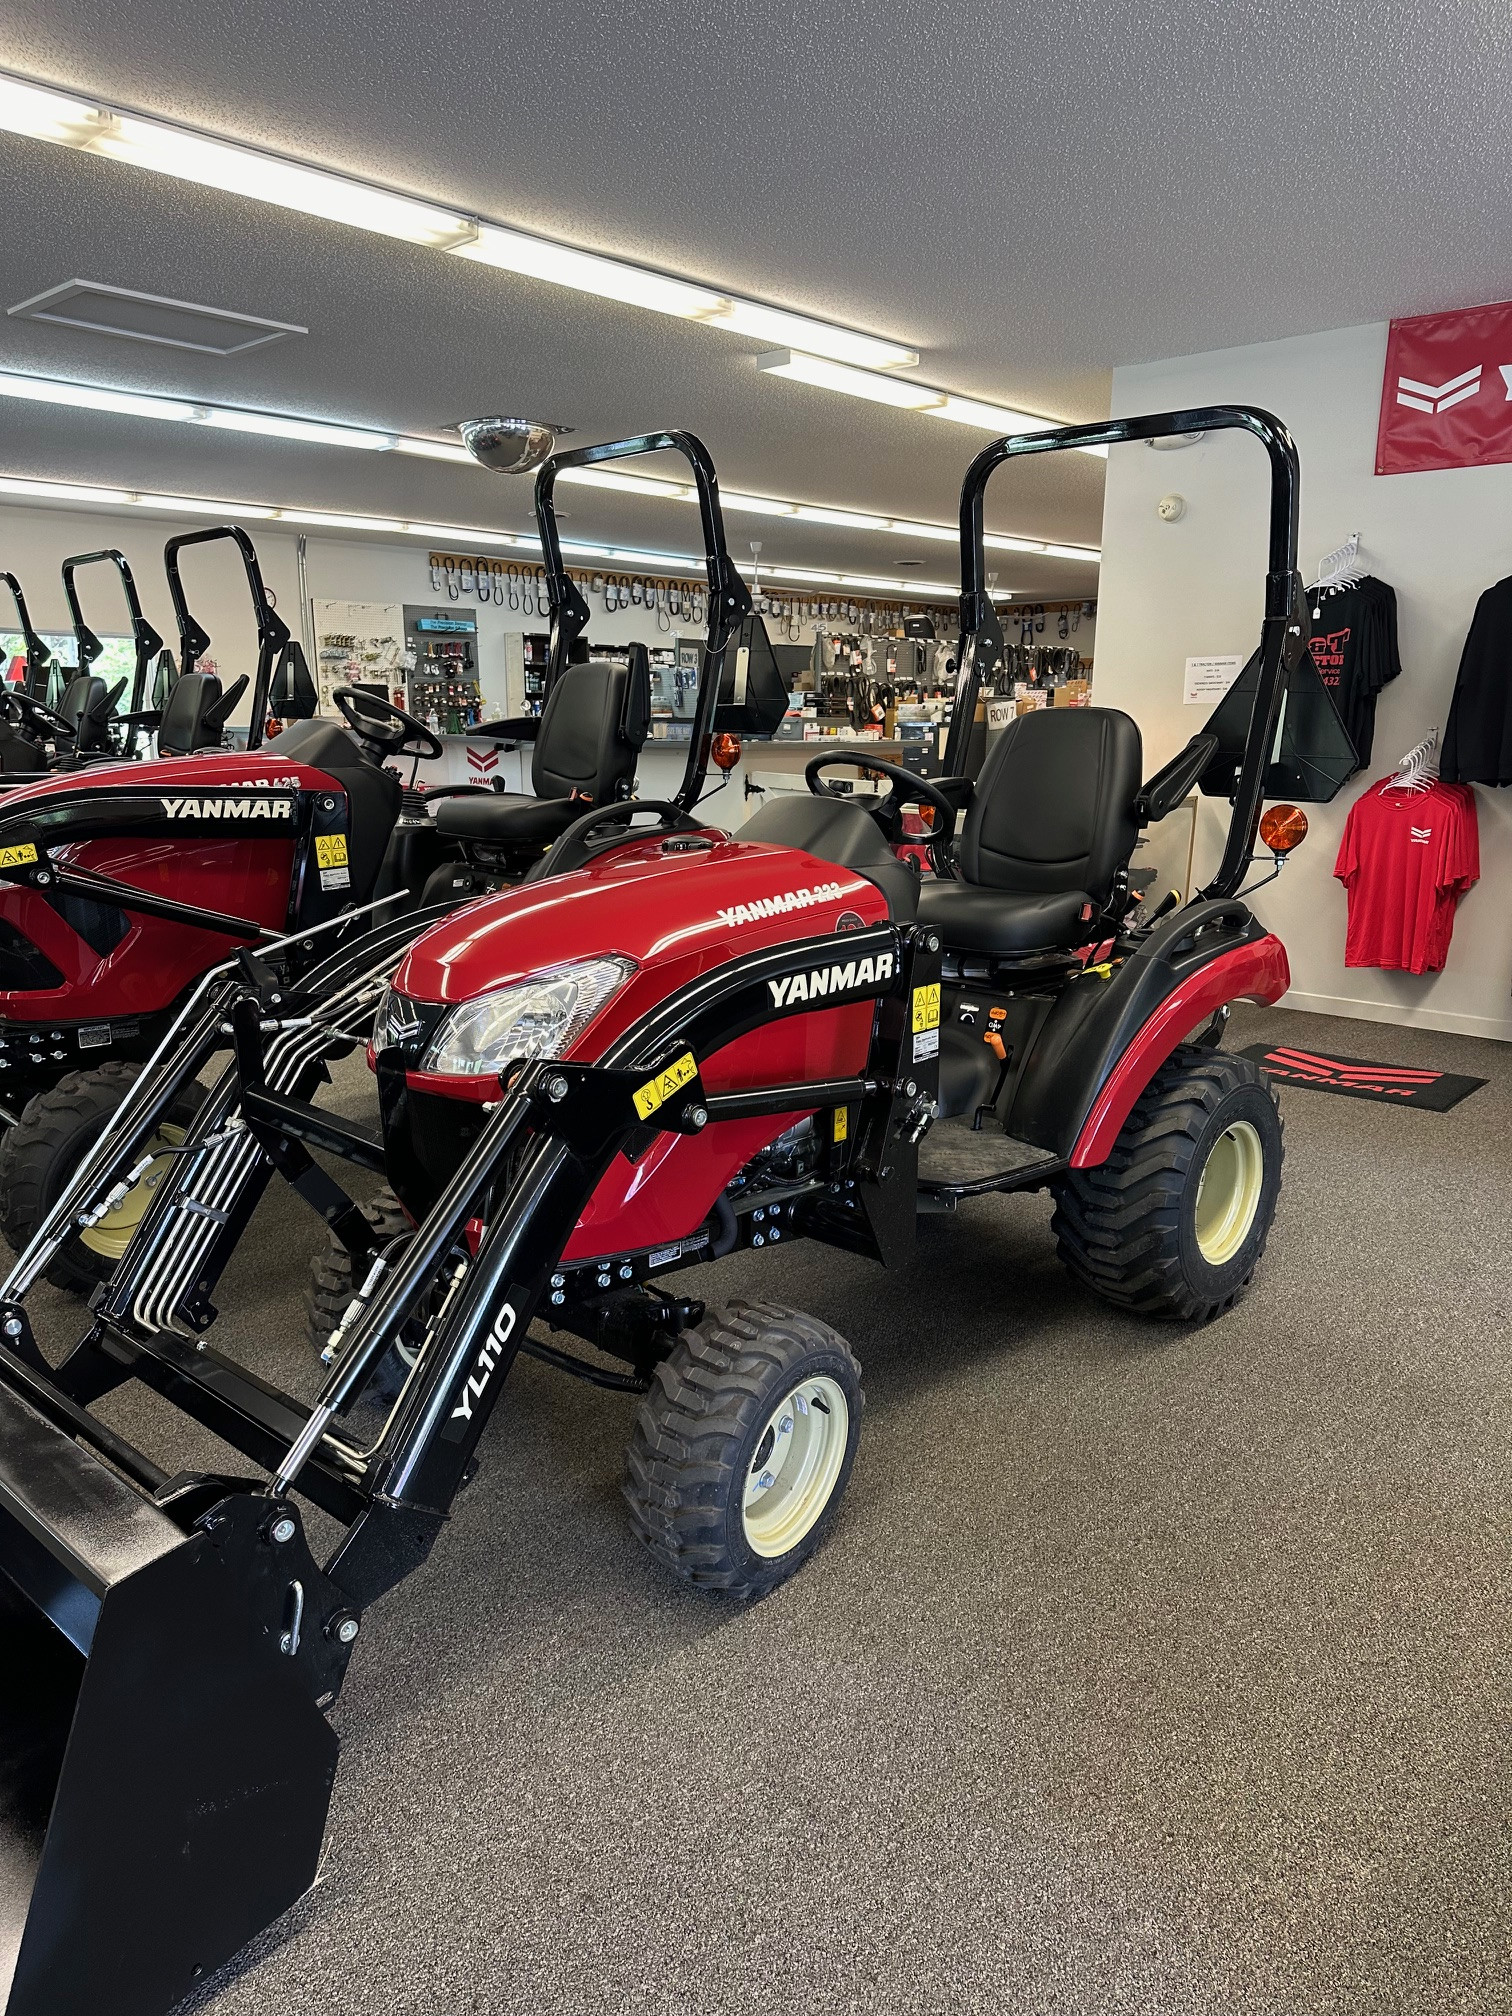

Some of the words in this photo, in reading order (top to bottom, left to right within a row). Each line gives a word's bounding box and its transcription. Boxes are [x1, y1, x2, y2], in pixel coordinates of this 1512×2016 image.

[681, 653, 693, 663] ROW
[693, 654, 698, 664] 3
[990, 708, 1008, 723] ROW
[1010, 707, 1015, 719] 7
[161, 799, 291, 818] YANMAR
[717, 888, 815, 927] YANMAR
[814, 882, 843, 904] 223
[768, 952, 894, 1008] YANMAR
[1259, 1066, 1418, 1097] ANMAR
[450, 1303, 516, 1420] YL110
